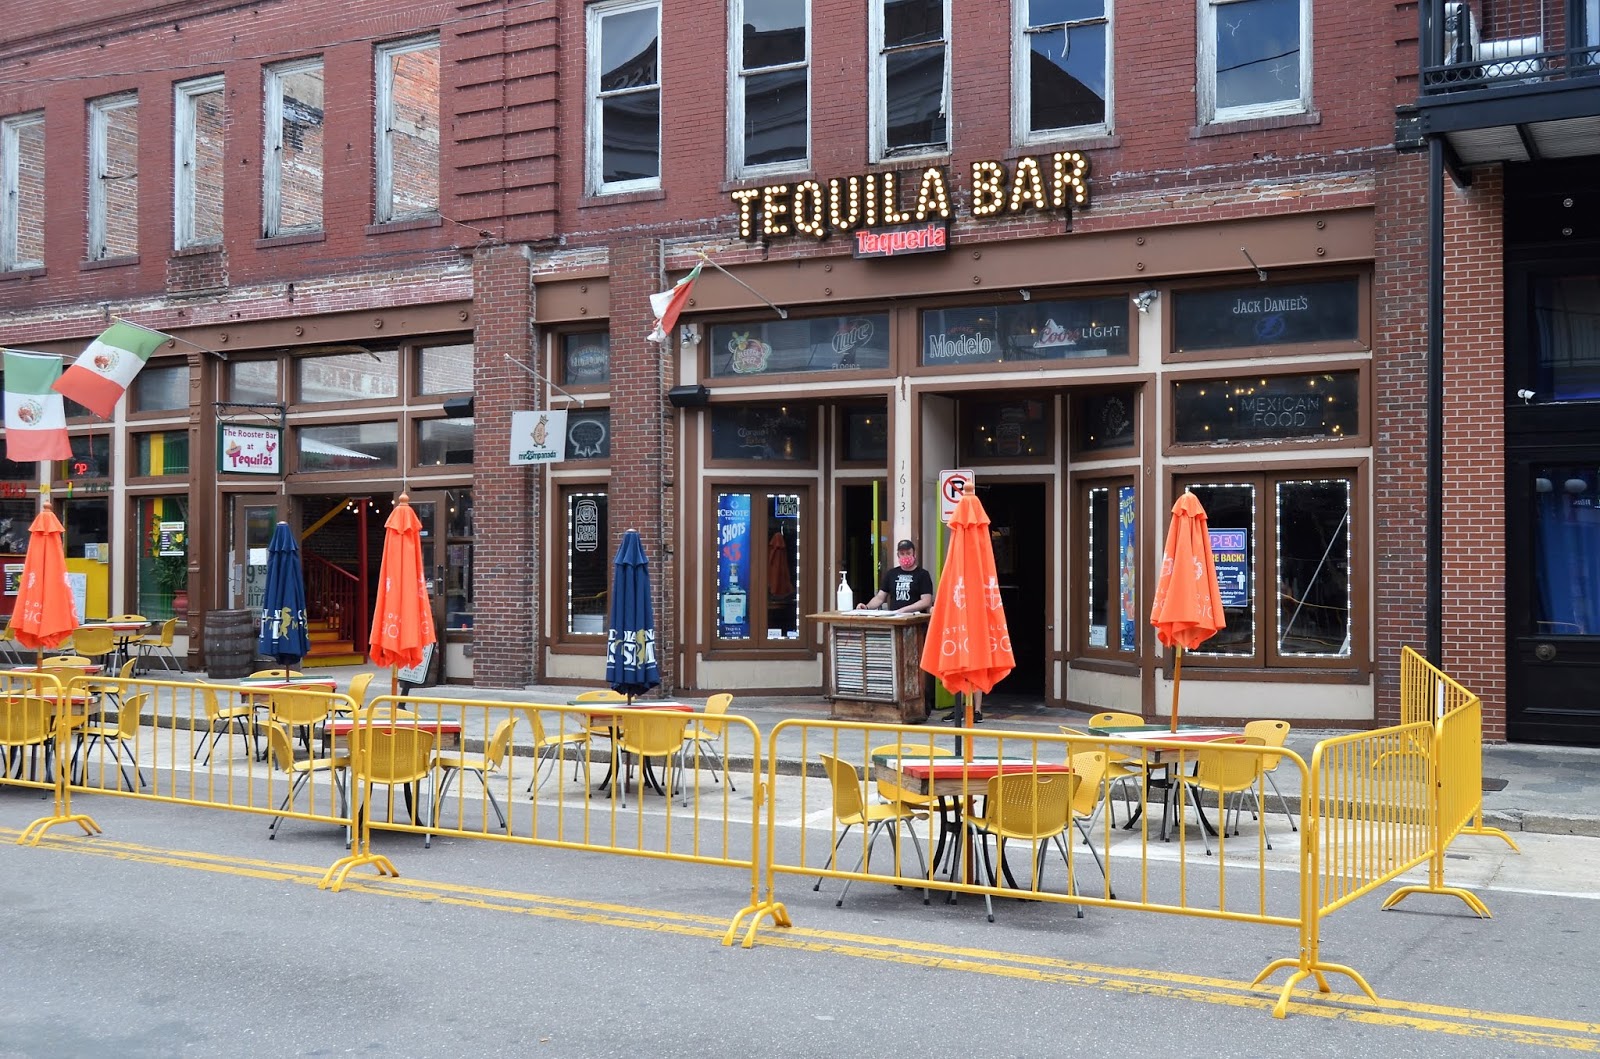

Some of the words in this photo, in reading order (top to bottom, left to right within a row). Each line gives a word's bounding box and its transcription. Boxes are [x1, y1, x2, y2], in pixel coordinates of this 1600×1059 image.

[731, 166, 950, 240] TEQUILA
[970, 150, 1091, 218] BAR
[855, 225, 946, 256] Taqueria
[1232, 299, 1261, 314] JACK
[1264, 296, 1308, 312] DANIEL'S
[1039, 327, 1081, 344] Coors
[1082, 325, 1121, 339] LIGHT
[929, 332, 992, 358] Modelo
[1241, 397, 1319, 412] MEXICAN
[1253, 412, 1307, 427] FOOD
[223, 428, 236, 437] The
[238, 429, 264, 438] Rooster
[229, 450, 272, 468] Tequilas
[720, 508, 749, 517] CENOTE
[722, 522, 746, 545] SHOTS
[1209, 534, 1243, 548] PEN
[1220, 554, 1245, 562] BACK!
